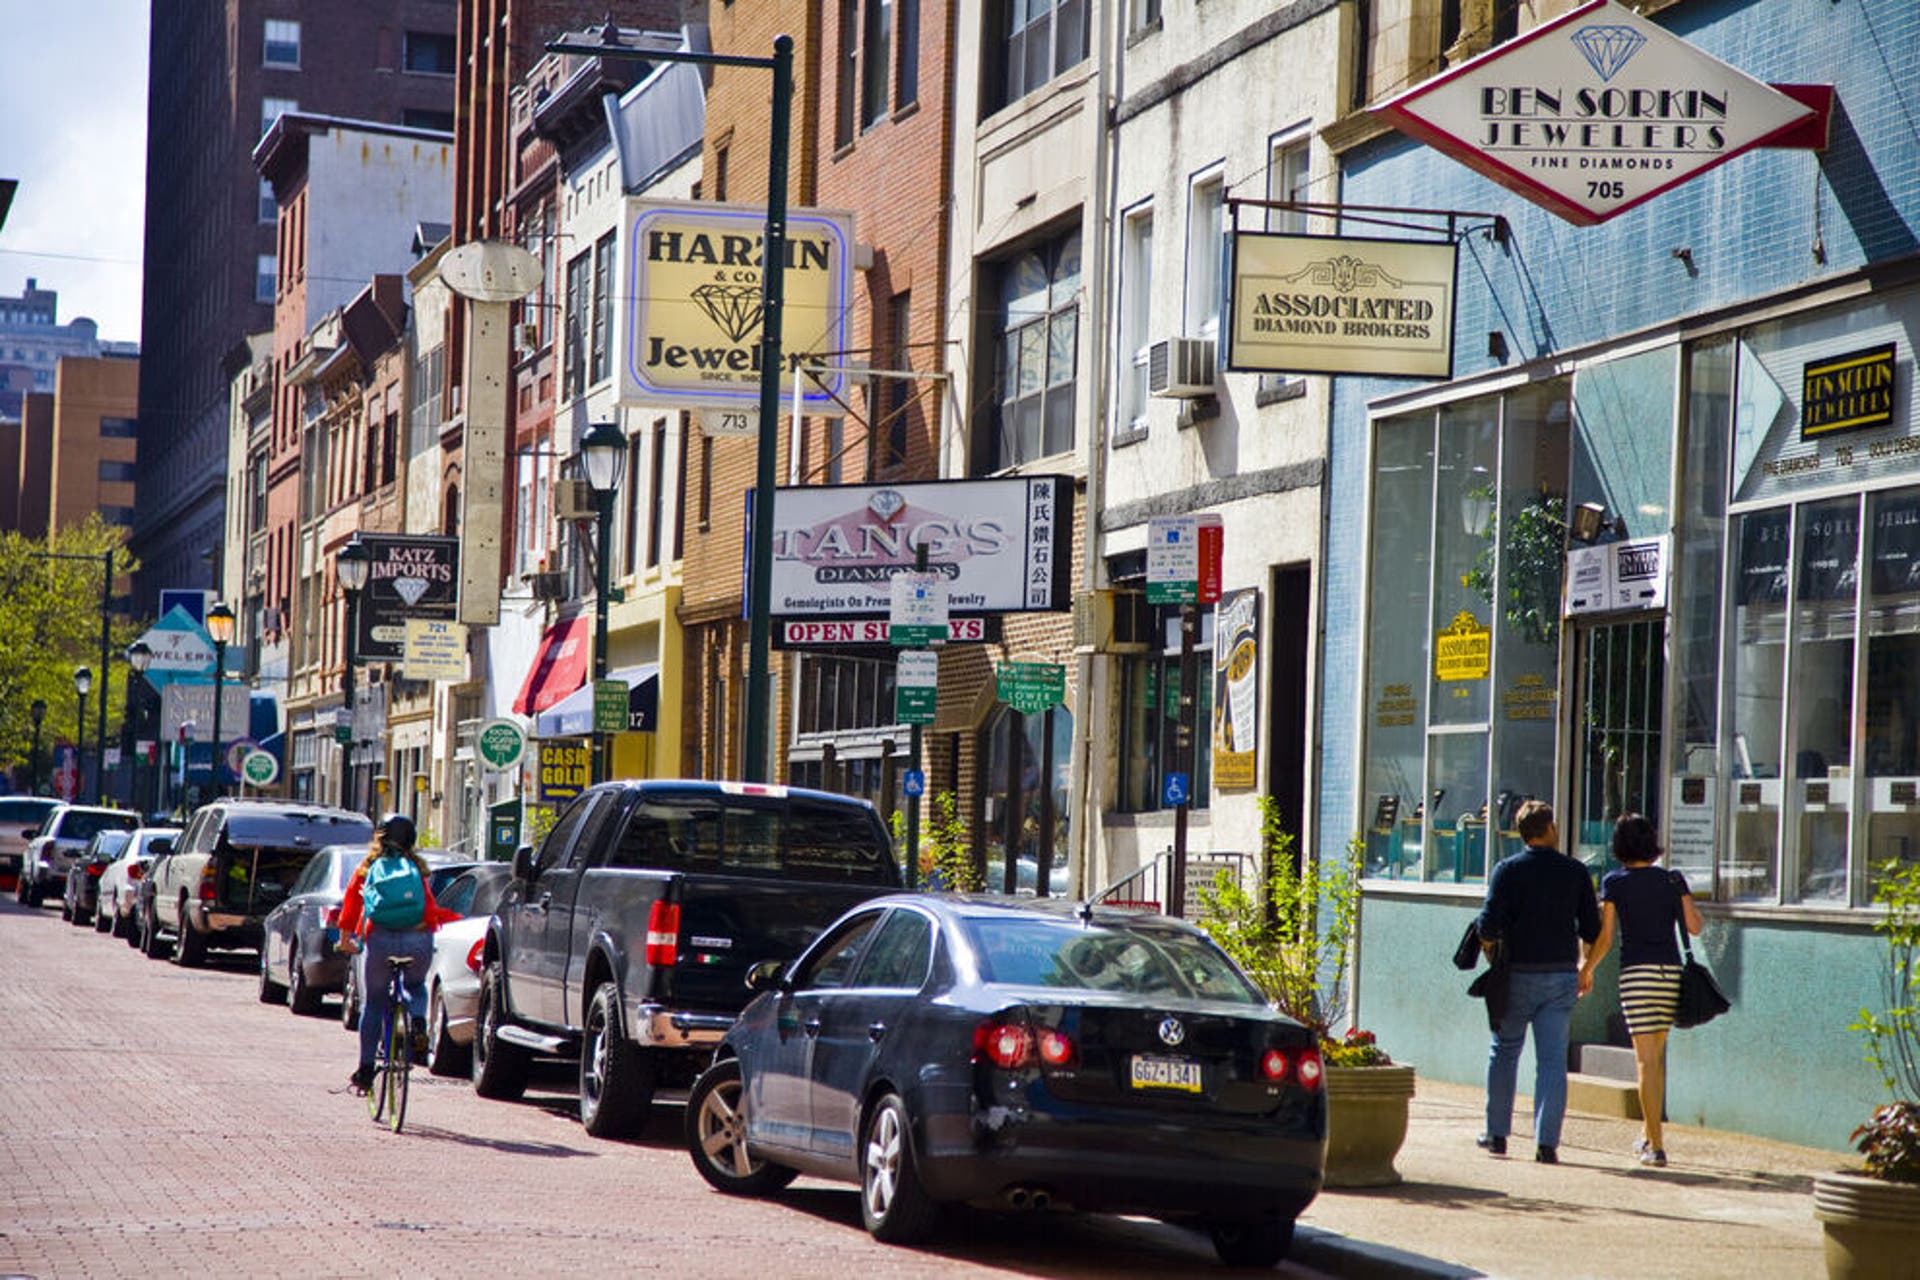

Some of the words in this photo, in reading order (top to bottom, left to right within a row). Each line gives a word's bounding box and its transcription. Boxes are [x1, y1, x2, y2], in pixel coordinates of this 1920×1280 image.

[1481, 87, 1562, 116] BEN
[1576, 88, 1728, 119] SORKIN
[1479, 123, 1726, 149] JEWELERS
[1531, 157, 1569, 169] FINE
[1580, 157, 1674, 170] DIAMONDS
[1587, 182, 1624, 199] 705
[714, 270, 726, 282] &
[1253, 293, 1434, 321] ASSOCIATED
[1253, 317, 1337, 335] DIAMOND
[1341, 323, 1431, 339] BROKERS
[722, 414, 748, 429] 713
[388, 547, 436, 562] KATZ
[371, 561, 451, 582] IMPORTS
[784, 595, 847, 610] Gemologists
[850, 596, 862, 607] On
[788, 622, 855, 642] OPEN
[543, 748, 586, 765] CASH
[542, 767, 585, 785] GOLD
